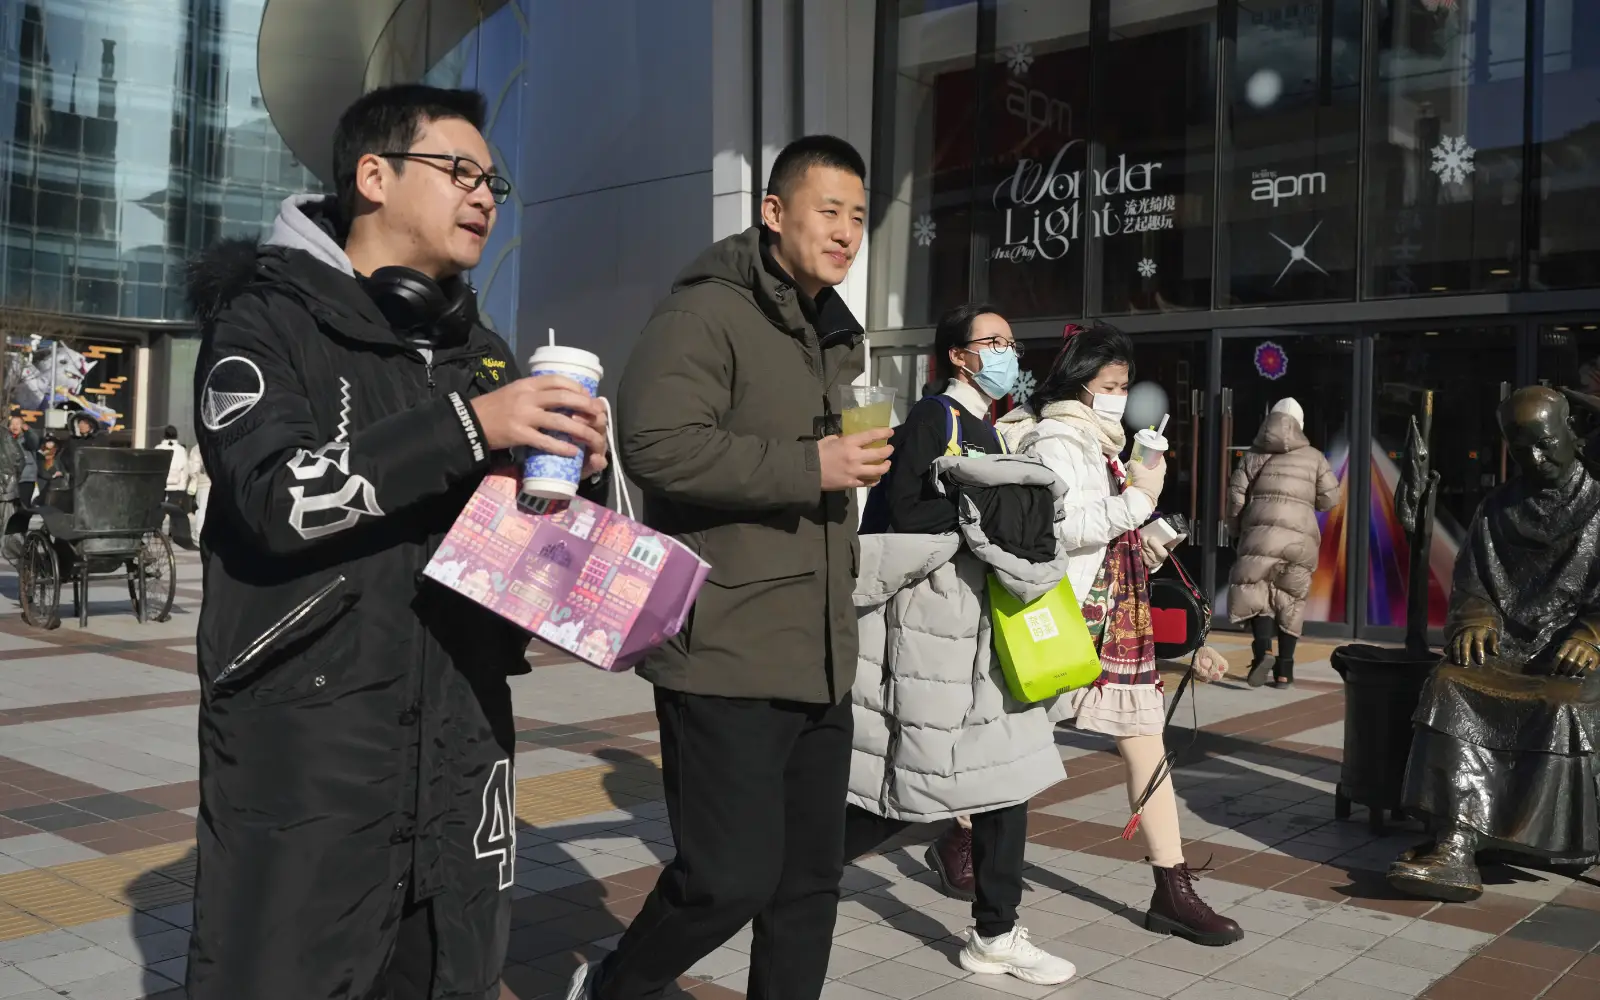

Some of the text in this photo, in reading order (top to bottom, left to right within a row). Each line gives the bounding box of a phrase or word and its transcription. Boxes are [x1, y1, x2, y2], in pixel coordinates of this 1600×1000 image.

[993, 139, 1162, 208] Wonder
[1251, 172, 1326, 207] apm
[1005, 200, 1121, 260] Light
